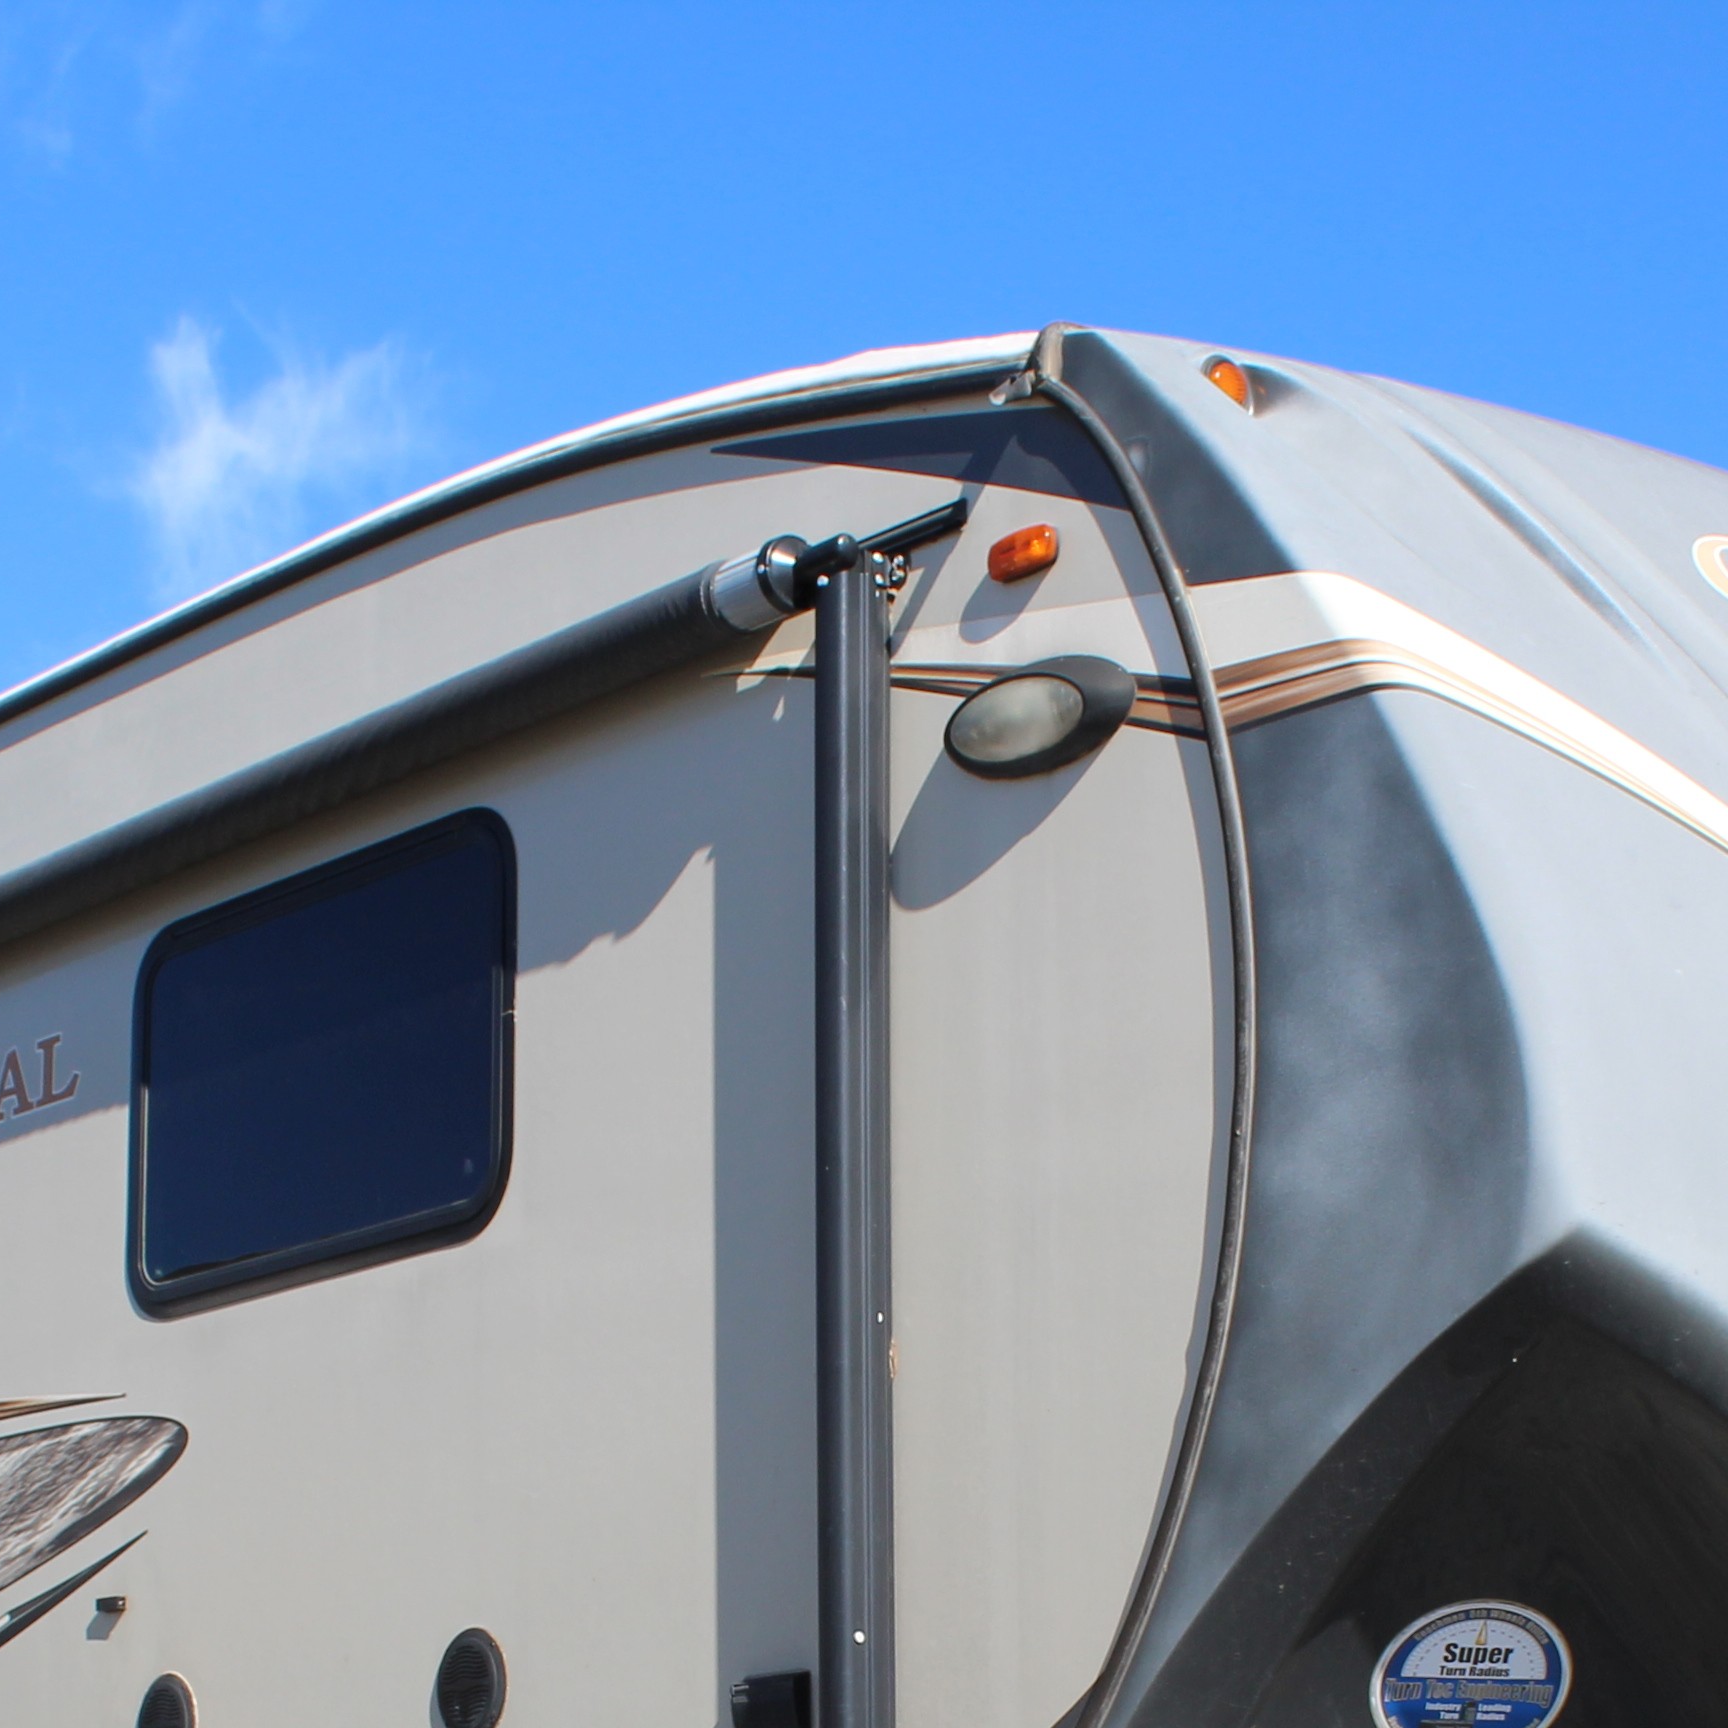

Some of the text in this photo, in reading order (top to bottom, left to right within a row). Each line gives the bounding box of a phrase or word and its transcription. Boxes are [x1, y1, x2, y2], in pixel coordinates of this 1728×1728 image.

[1443, 1642, 1514, 1665] Super
[1439, 1665, 1510, 1678] Turn Radius
[1384, 1678, 1422, 1702] Turn
[1455, 1680, 1555, 1708] Engineering
